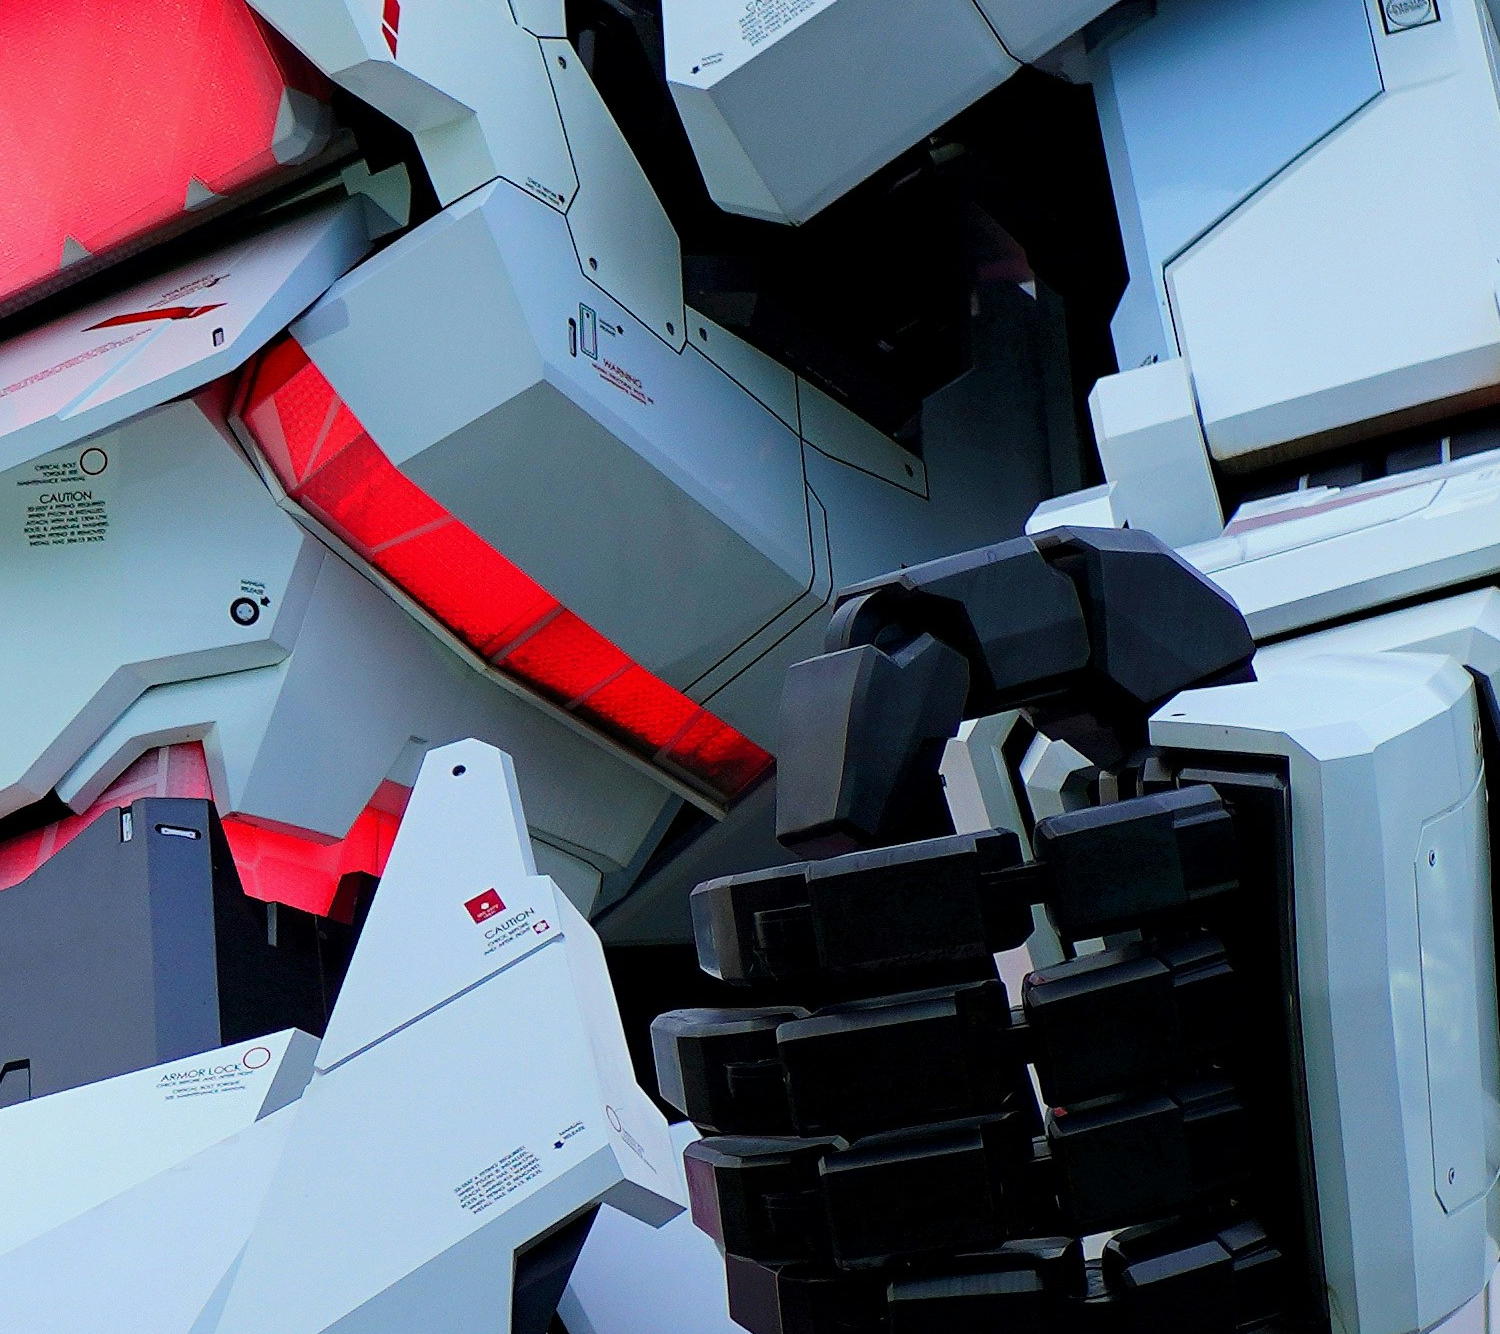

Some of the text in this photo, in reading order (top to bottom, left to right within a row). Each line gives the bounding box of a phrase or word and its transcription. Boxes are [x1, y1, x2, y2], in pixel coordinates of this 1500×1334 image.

[39, 490, 93, 504] CAUTION
[485, 907, 535, 940] CAUTION
[160, 1063, 242, 1082] ARMOR LOCK
